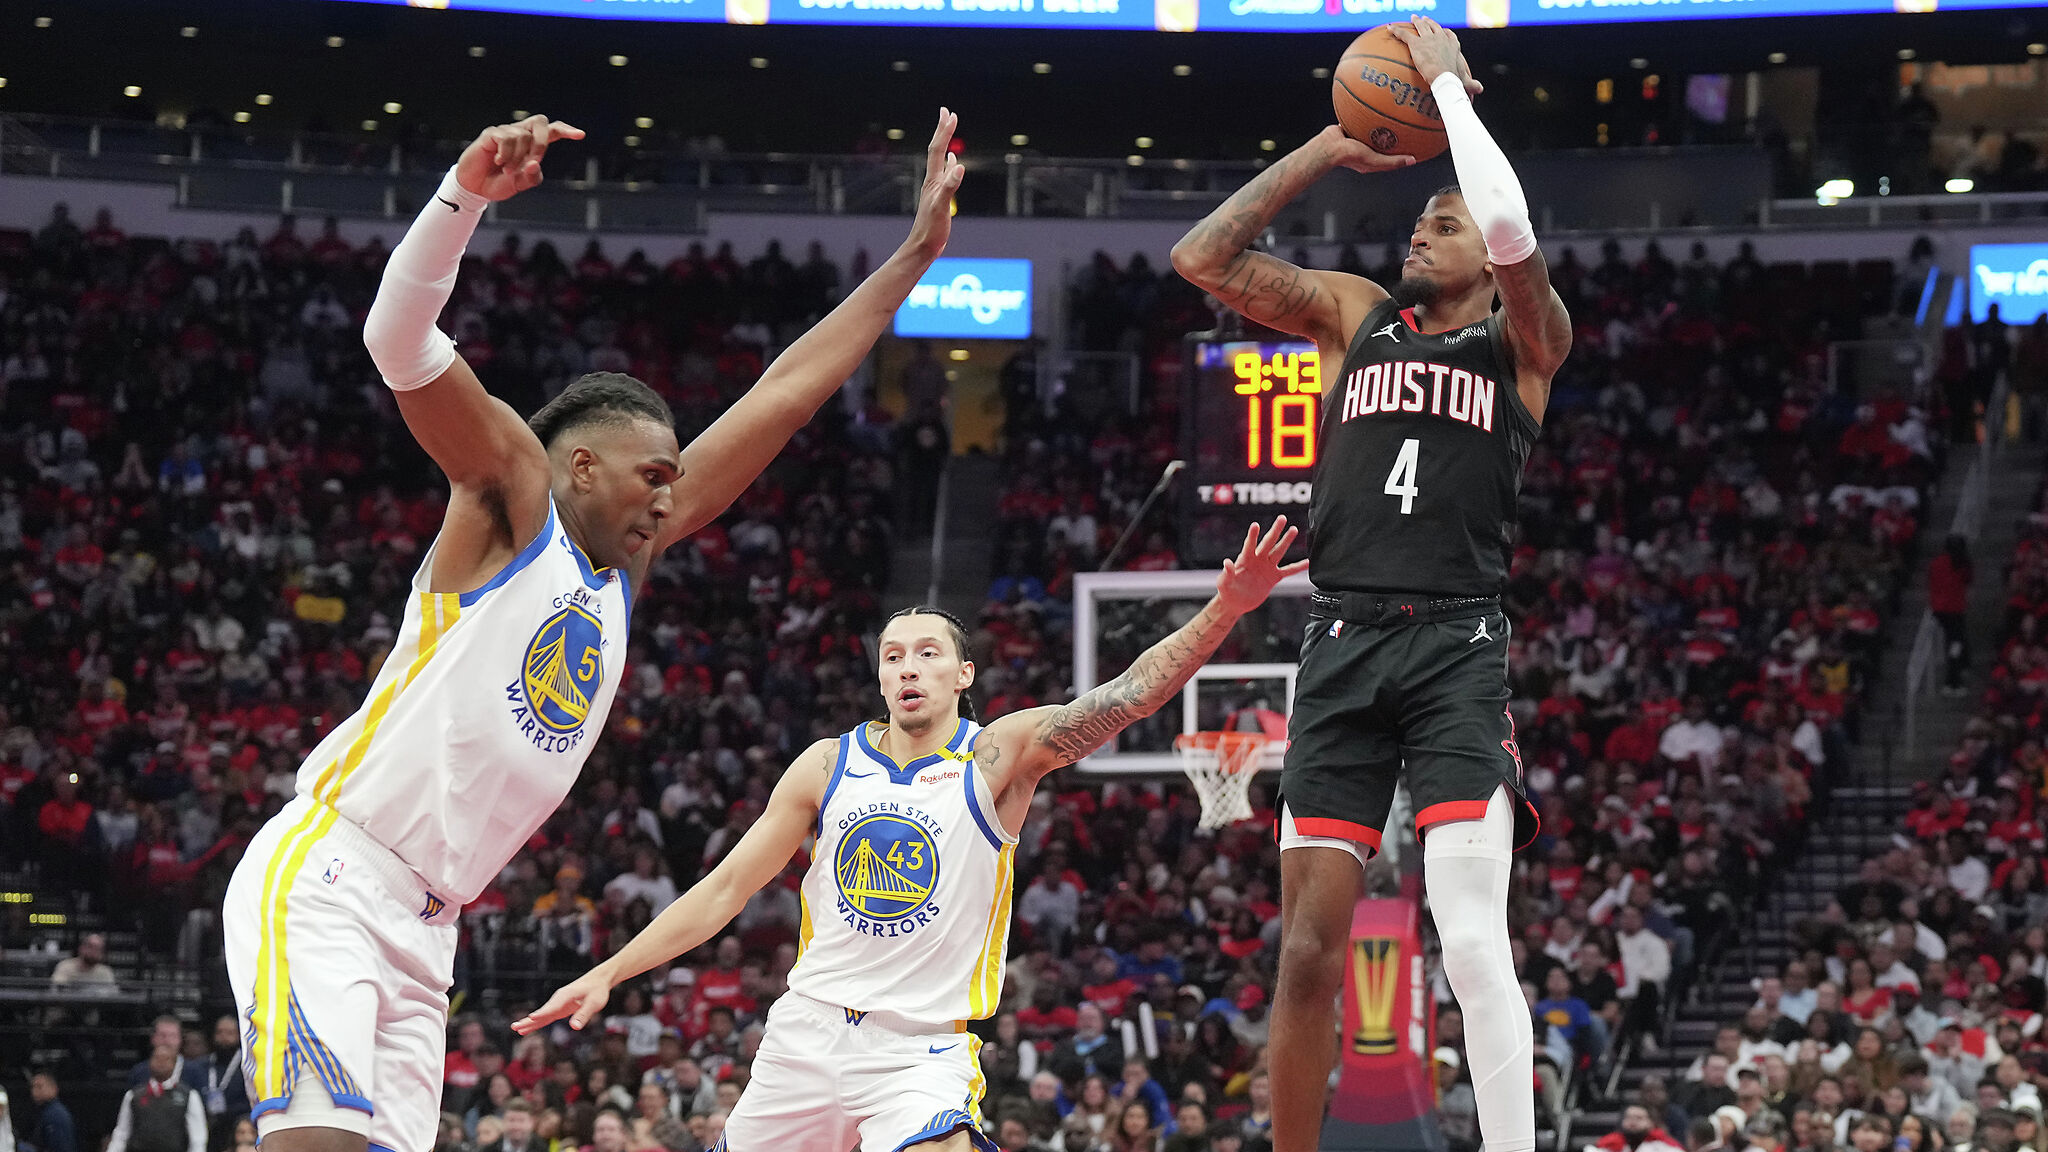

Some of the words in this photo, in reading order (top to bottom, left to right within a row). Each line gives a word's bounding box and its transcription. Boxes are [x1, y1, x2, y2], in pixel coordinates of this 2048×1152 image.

[1234, 351, 1322, 395] 9:43
[1341, 360, 1496, 434] HOUSTON
[1248, 394, 1316, 469] 18
[1384, 438, 1420, 515] 4
[577, 645, 601, 682] 5
[919, 770, 960, 785] Rakuten
[837, 801, 899, 831] GOLDEN
[905, 806, 944, 839] STATE
[886, 839, 925, 872] 43
[835, 893, 941, 938] WARRIORS
